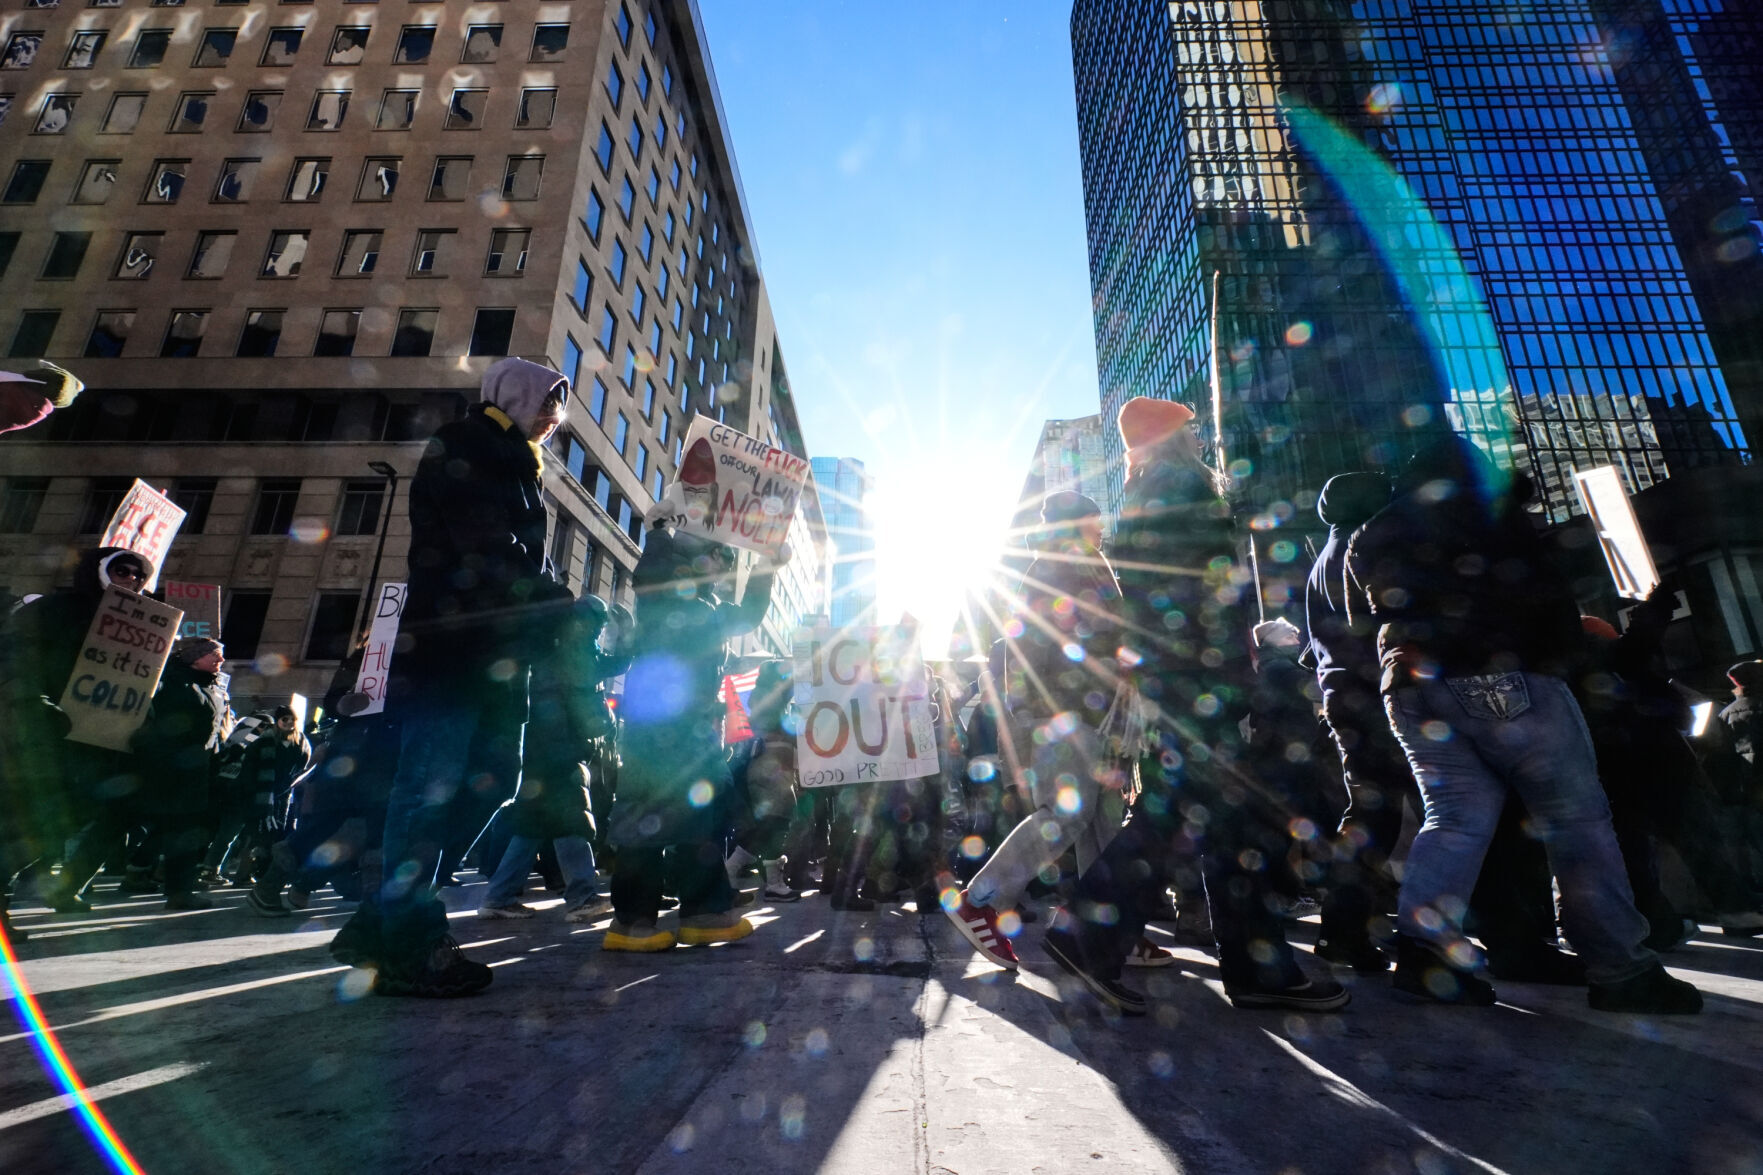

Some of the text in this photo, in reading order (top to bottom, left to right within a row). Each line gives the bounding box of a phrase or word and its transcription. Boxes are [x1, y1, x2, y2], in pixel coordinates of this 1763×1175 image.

[710, 425, 807, 482] GET THE FUCK
[720, 454, 758, 479] OFF OUR
[752, 472, 800, 508] LAWN
[118, 503, 168, 549] ICE
[167, 581, 217, 600] HOT
[377, 585, 407, 618] BI
[108, 590, 168, 628] I'm as
[97, 613, 167, 655] PISSED
[182, 621, 210, 637] CE
[84, 647, 151, 678] as it is
[362, 641, 390, 672] HU
[71, 674, 147, 716] COLD!
[362, 676, 387, 701] RI
[805, 694, 924, 759] OUT
[803, 769, 844, 786] GOOD
